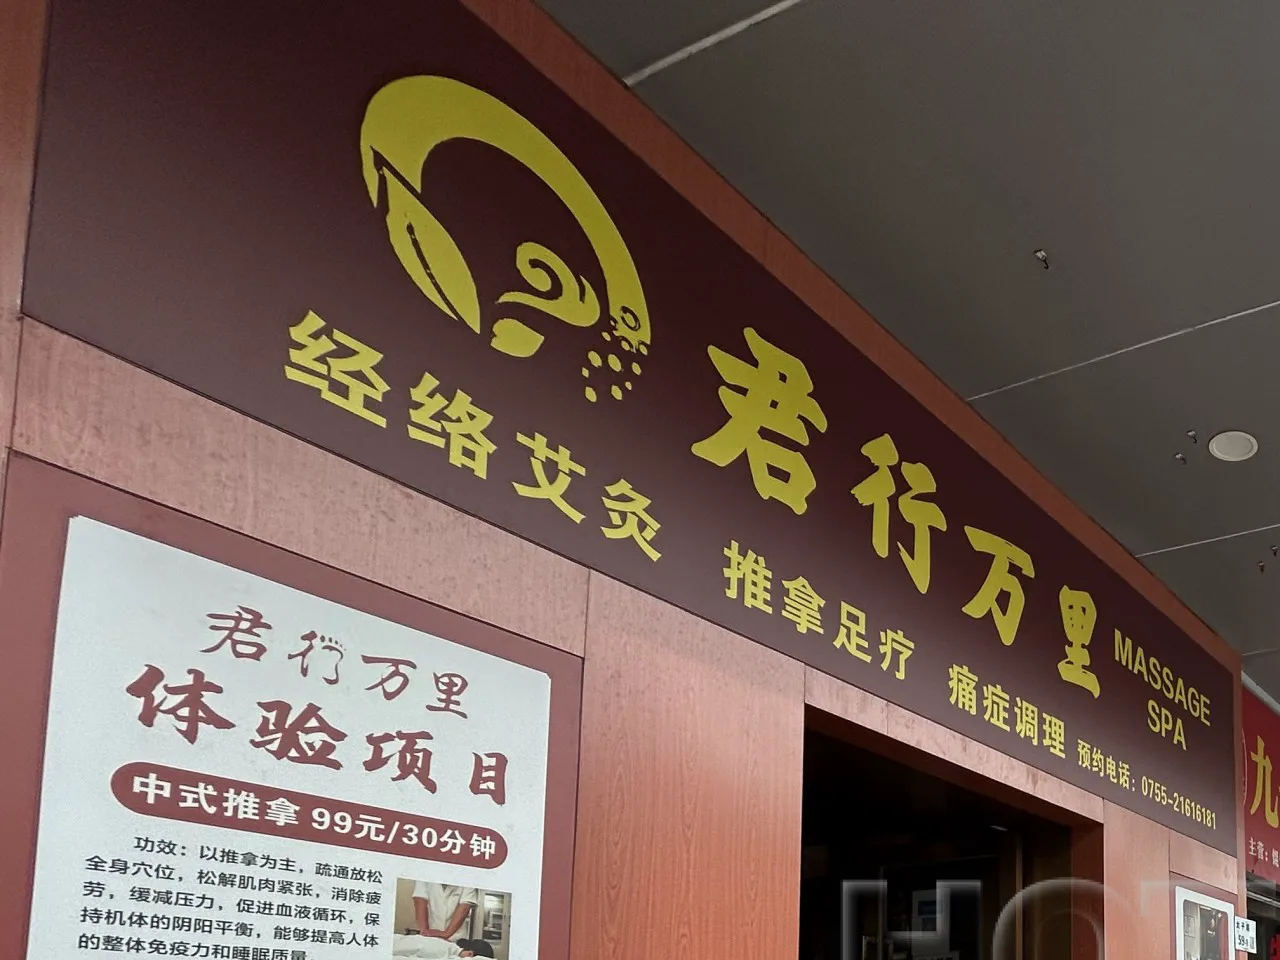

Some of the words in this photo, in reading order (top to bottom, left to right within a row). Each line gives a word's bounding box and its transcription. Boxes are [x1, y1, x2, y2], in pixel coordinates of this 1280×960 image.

[283, 309, 663, 562] 经络艾灸
[691, 327, 1101, 699] 君行万里
[200, 606, 470, 719] 君行万里
[722, 539, 915, 680] 推拿足疗
[948, 664, 1066, 759] 痛症调理
[1114, 628, 1210, 727] MASSAGE
[1147, 699, 1187, 751] SPA
[126, 663, 509, 806] 体验项目
[132, 773, 301, 827] 中式推拿
[311, 807, 496, 861] 99元/30分钟
